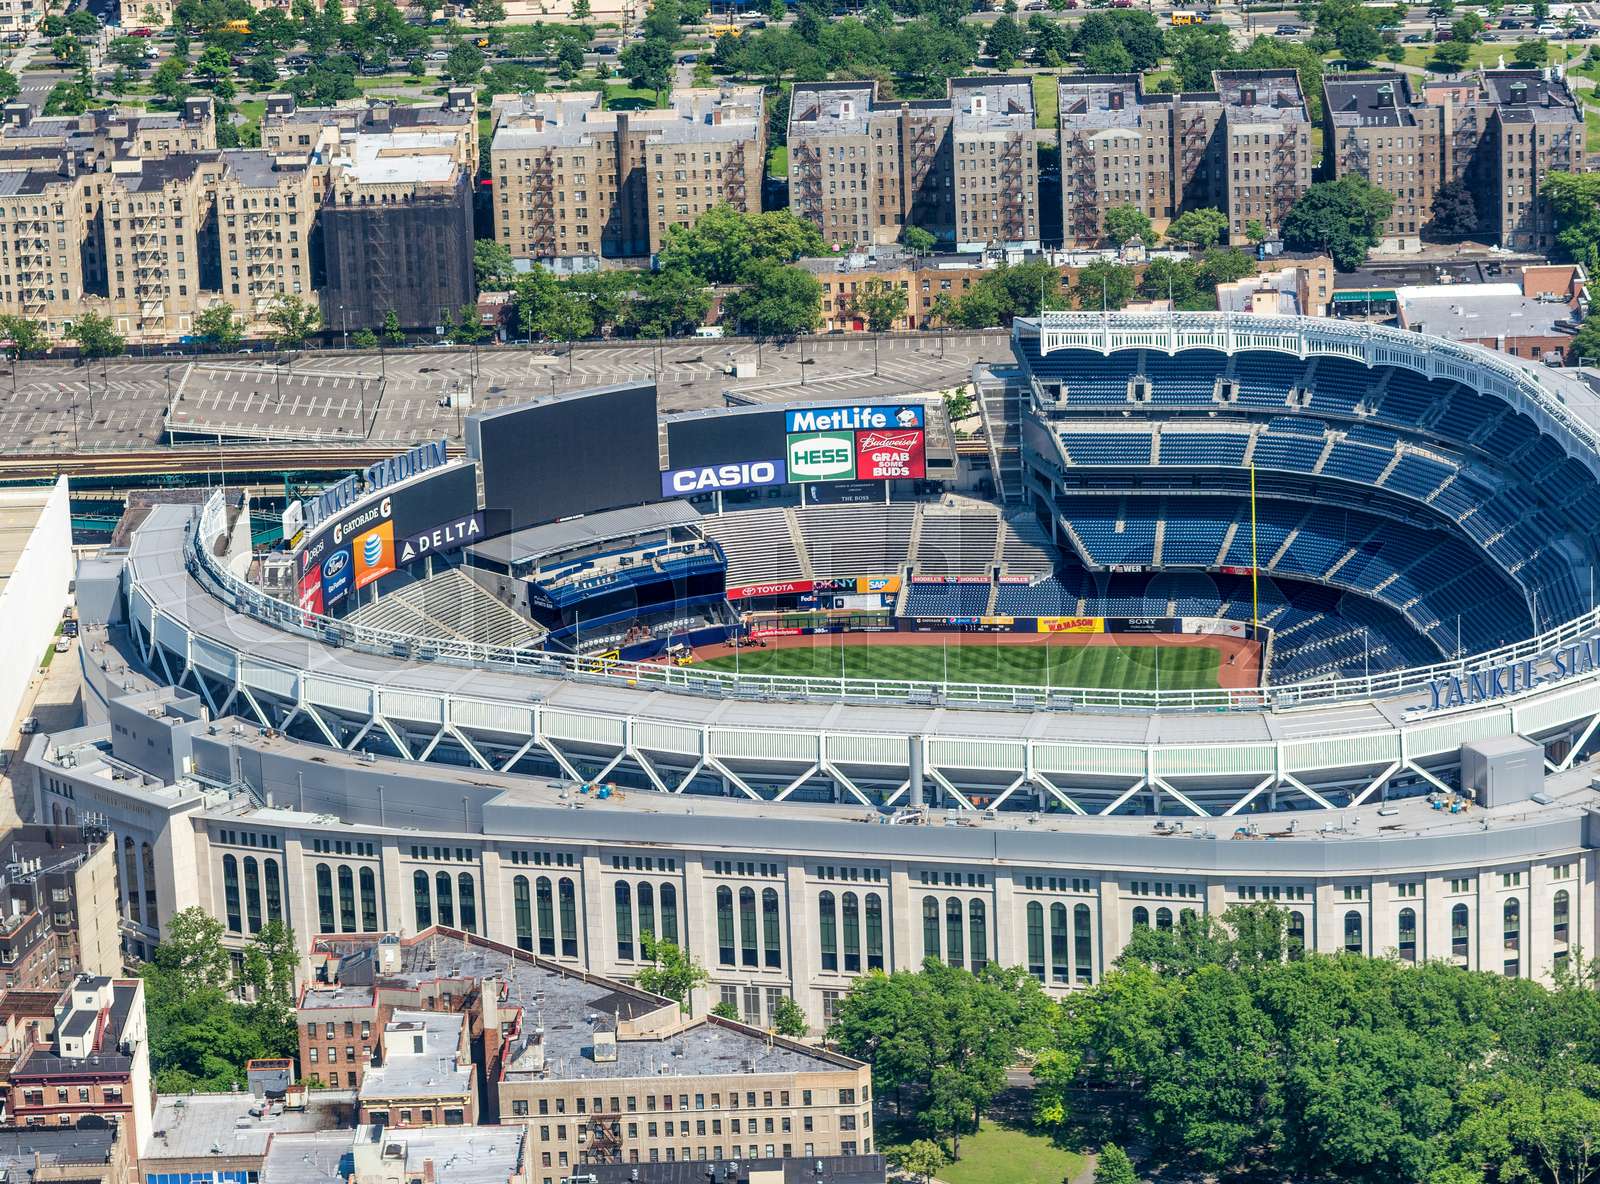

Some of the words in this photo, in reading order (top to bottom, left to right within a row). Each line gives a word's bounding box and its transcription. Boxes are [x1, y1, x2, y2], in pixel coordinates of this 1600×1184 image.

[792, 408, 887, 432] MetLife
[860, 437, 917, 449] Budweiser
[363, 440, 447, 492] STADIUM
[794, 450, 849, 466] HESS
[872, 452, 910, 462] GRAB
[673, 462, 775, 492] CASIO
[873, 467, 910, 476] BUDS
[342, 507, 380, 535] GATORADE
[419, 518, 480, 552] DELTA
[328, 555, 344, 576] Ford
[757, 583, 794, 594] TOYOTA
[813, 578, 856, 590] DKNY
[869, 580, 886, 589] SAP
[1424, 657, 1538, 709] YANKEE
